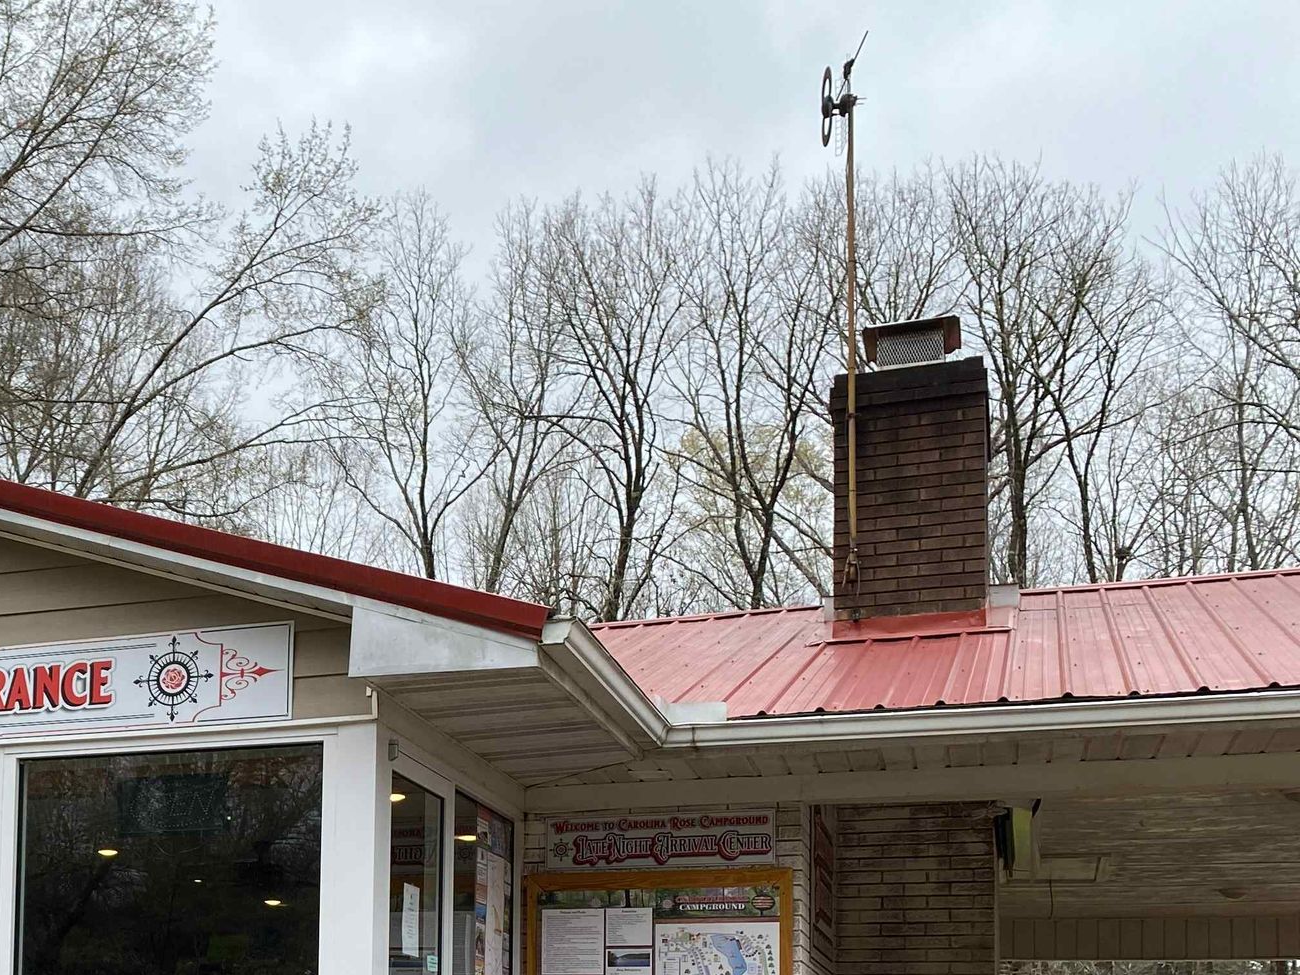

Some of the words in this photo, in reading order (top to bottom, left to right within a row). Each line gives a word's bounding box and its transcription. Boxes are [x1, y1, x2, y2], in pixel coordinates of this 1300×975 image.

[552, 821, 600, 835] WELCOME
[603, 822, 615, 831] TO
[618, 818, 667, 832] CAROLINA
[670, 816, 696, 831] ROSE
[700, 815, 769, 829] CAMPGROUND
[575, 835, 608, 862] LATE
[606, 833, 653, 861] NIGHT
[653, 833, 719, 861] ARRIVAL
[720, 830, 772, 857] CENTER
[679, 902, 746, 911] CAMPGROUND
